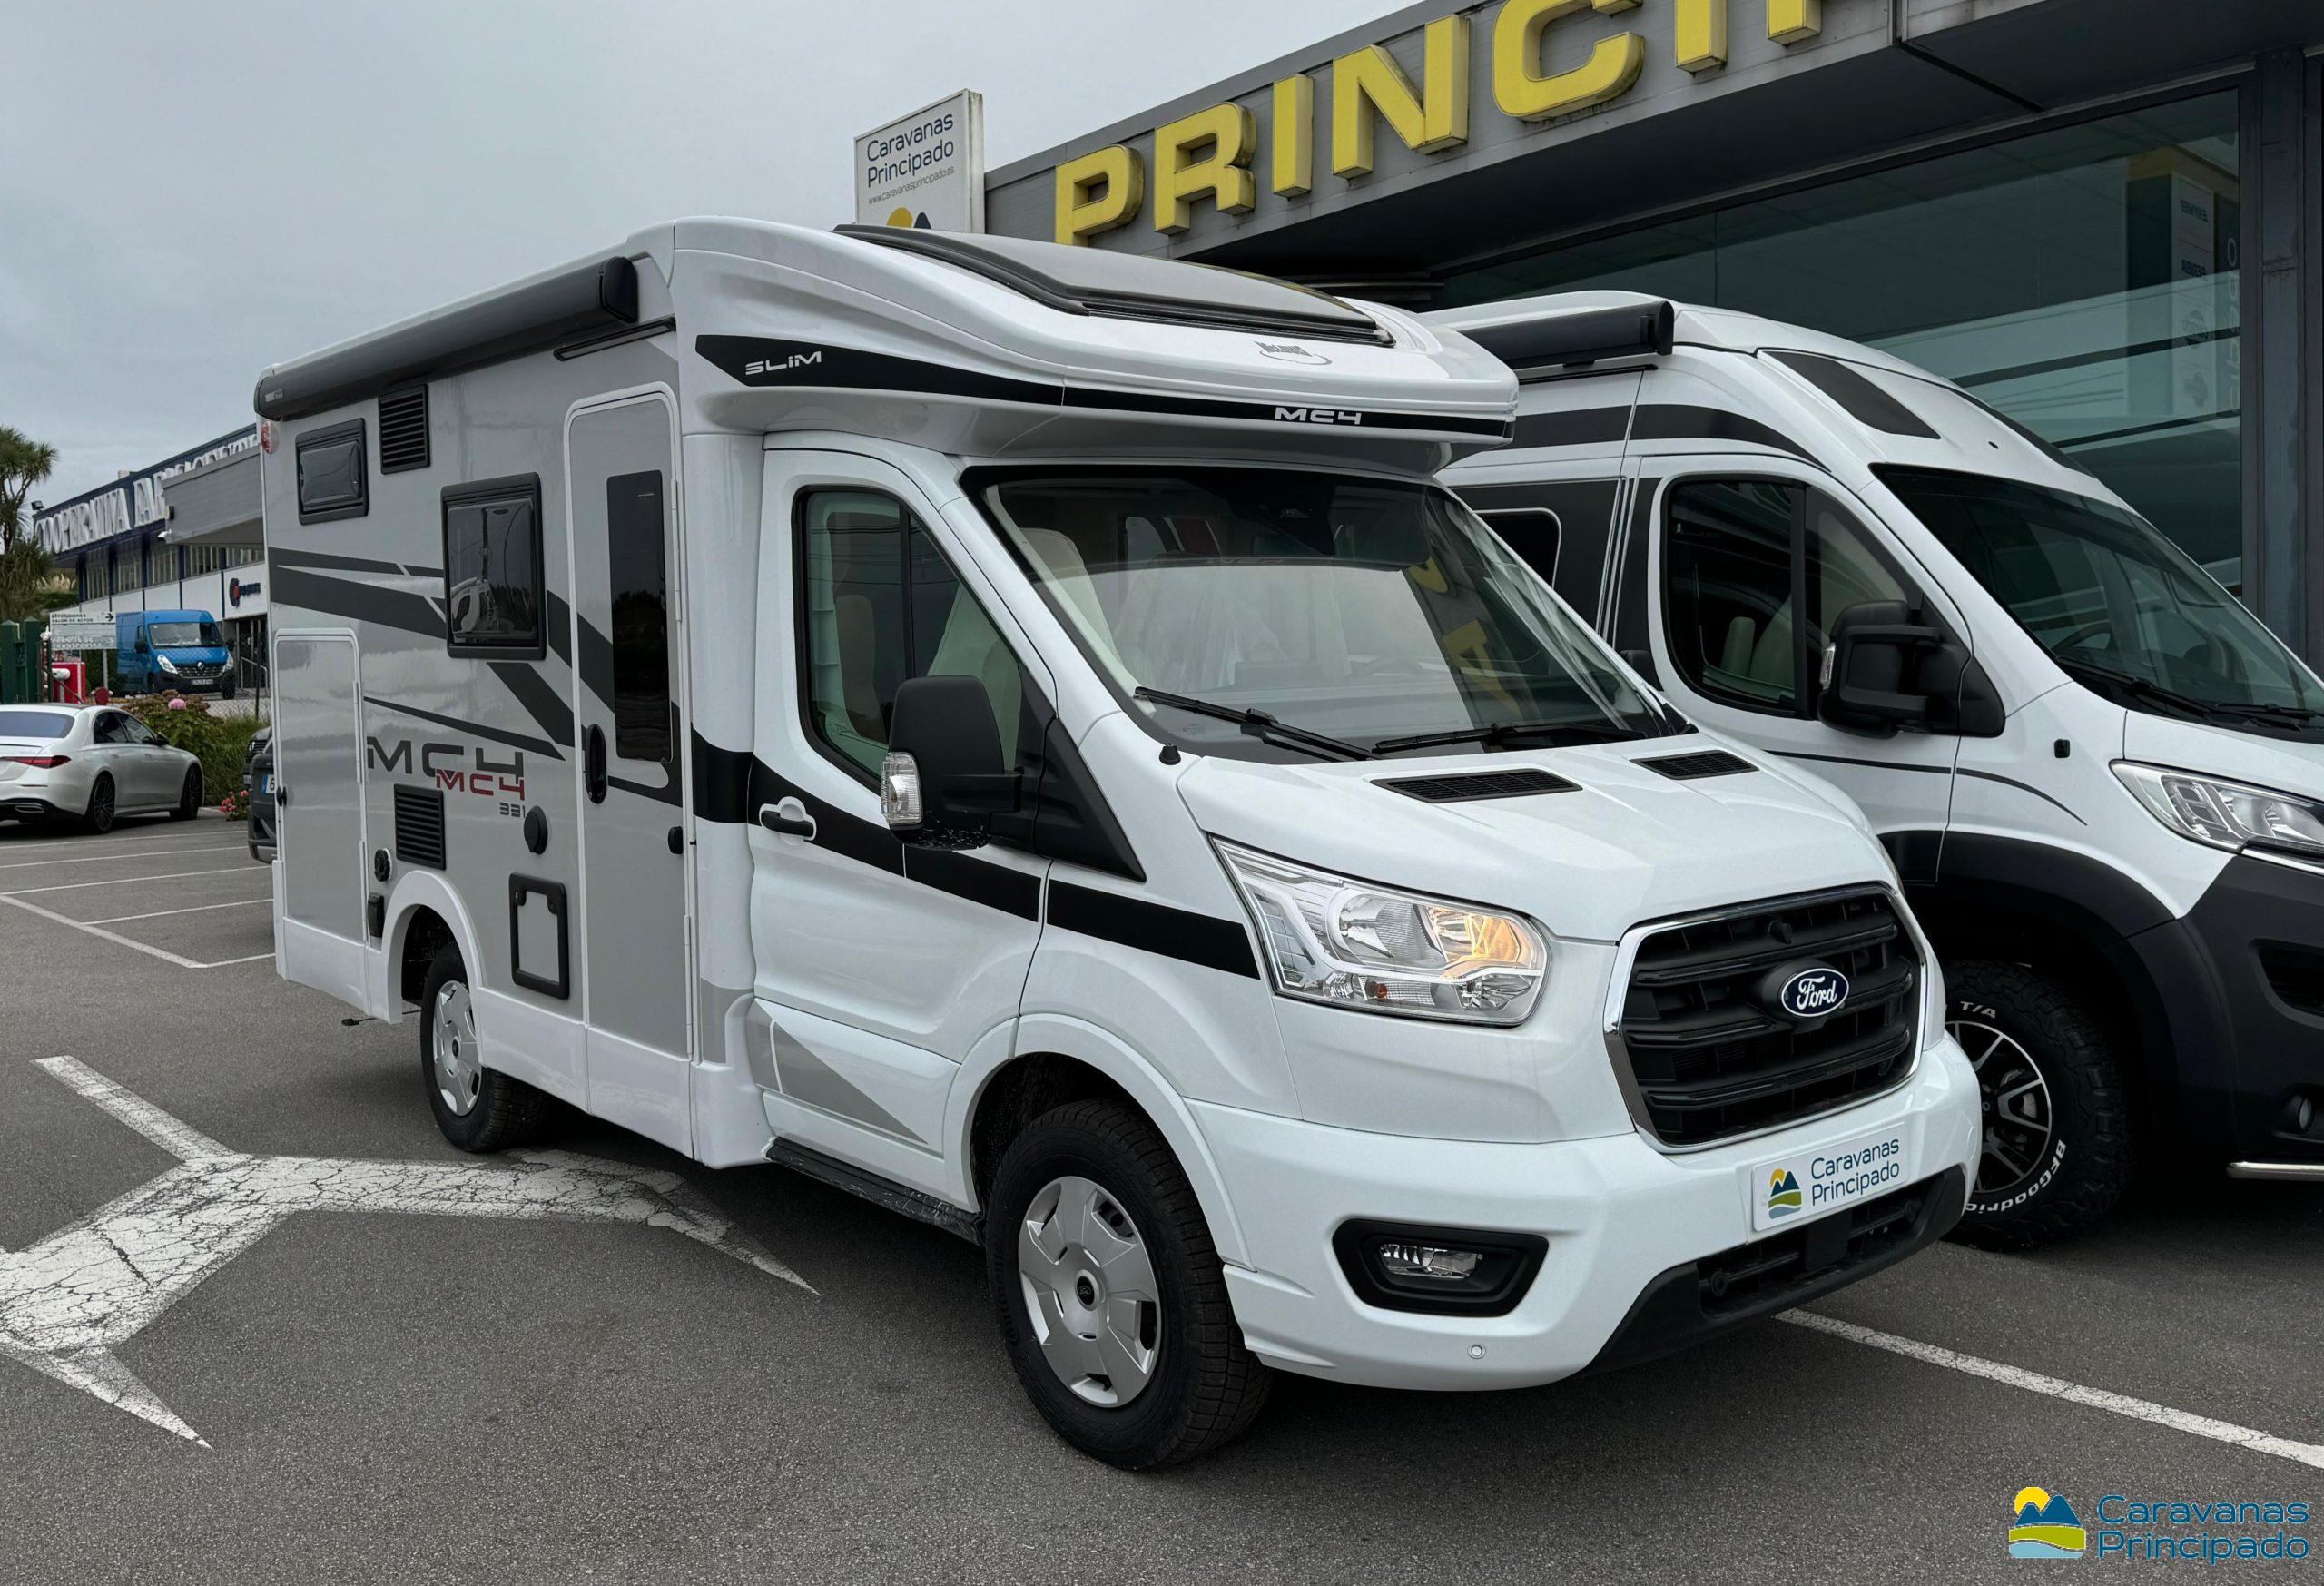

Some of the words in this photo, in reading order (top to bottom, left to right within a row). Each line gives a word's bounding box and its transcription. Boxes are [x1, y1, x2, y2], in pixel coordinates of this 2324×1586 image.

[867, 113, 953, 163] Caravanas
[868, 140, 954, 188] Principado
[1274, 407, 1362, 425] MC4
[367, 736, 524, 784] MC4
[436, 769, 525, 801] MC4
[1796, 975, 1838, 1010] Ford
[1960, 1000, 1997, 1019] T/A
[1811, 1138, 1900, 1180] Caravanas
[1812, 1160, 1900, 1207] Principado
